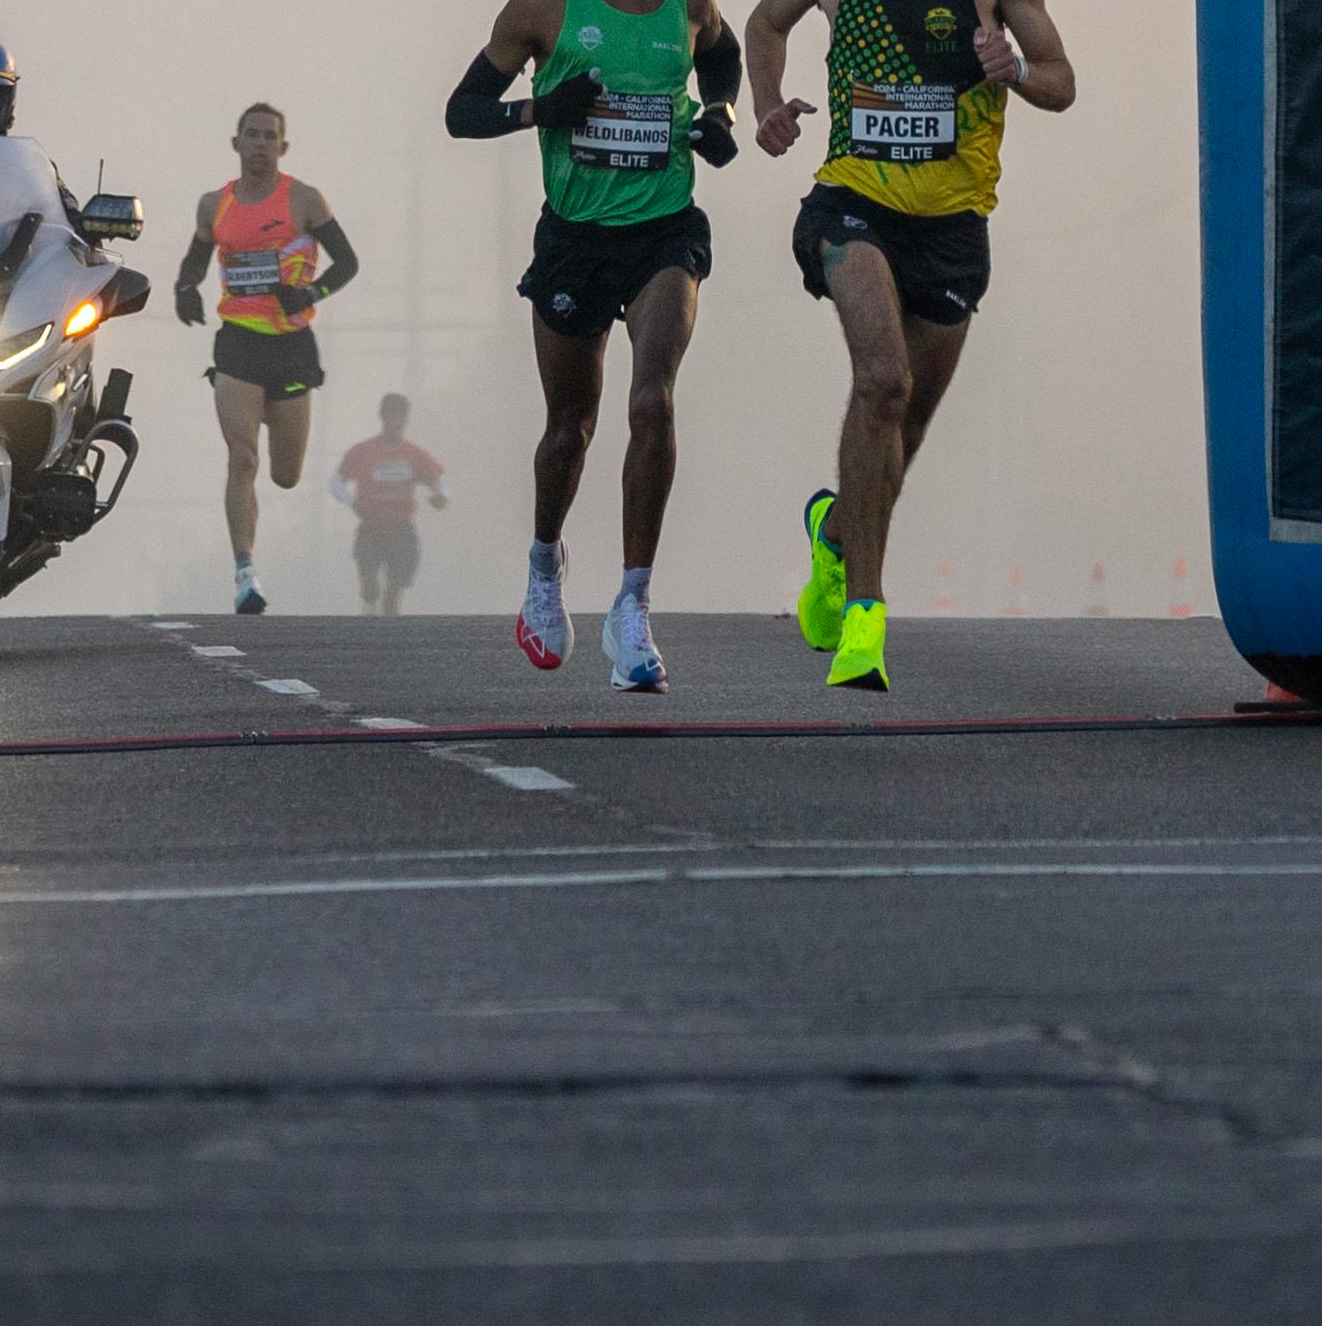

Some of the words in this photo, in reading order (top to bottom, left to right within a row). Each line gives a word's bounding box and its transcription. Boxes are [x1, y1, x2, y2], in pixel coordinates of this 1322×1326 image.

[902, 84, 955, 93] CALIFORNIA
[885, 93, 954, 101] INTERNATIONAL
[865, 114, 940, 139] PACER
[891, 146, 933, 159] ELITE
[610, 153, 649, 167] ELITE
